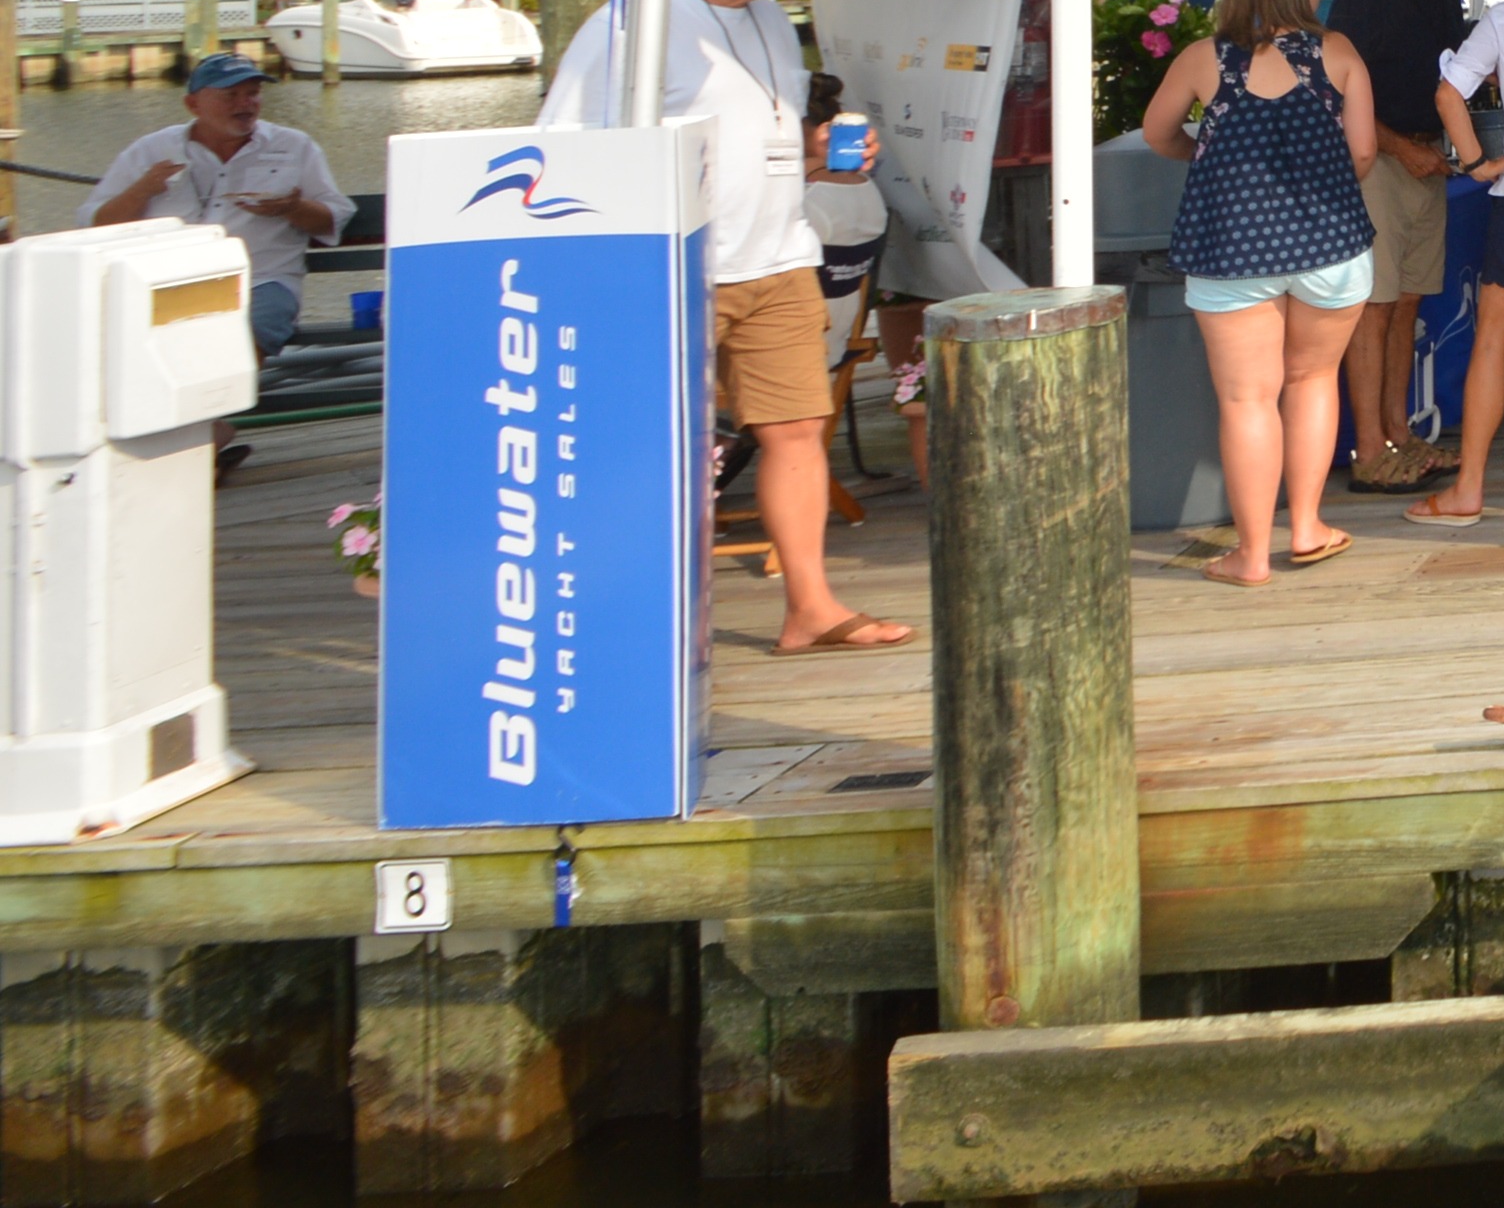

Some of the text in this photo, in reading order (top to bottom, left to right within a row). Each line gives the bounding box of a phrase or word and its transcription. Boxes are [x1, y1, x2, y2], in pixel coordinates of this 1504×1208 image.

[482, 258, 540, 787] Bluewater
[556, 323, 578, 715] YACHT SALES
[404, 870, 428, 920] 8
